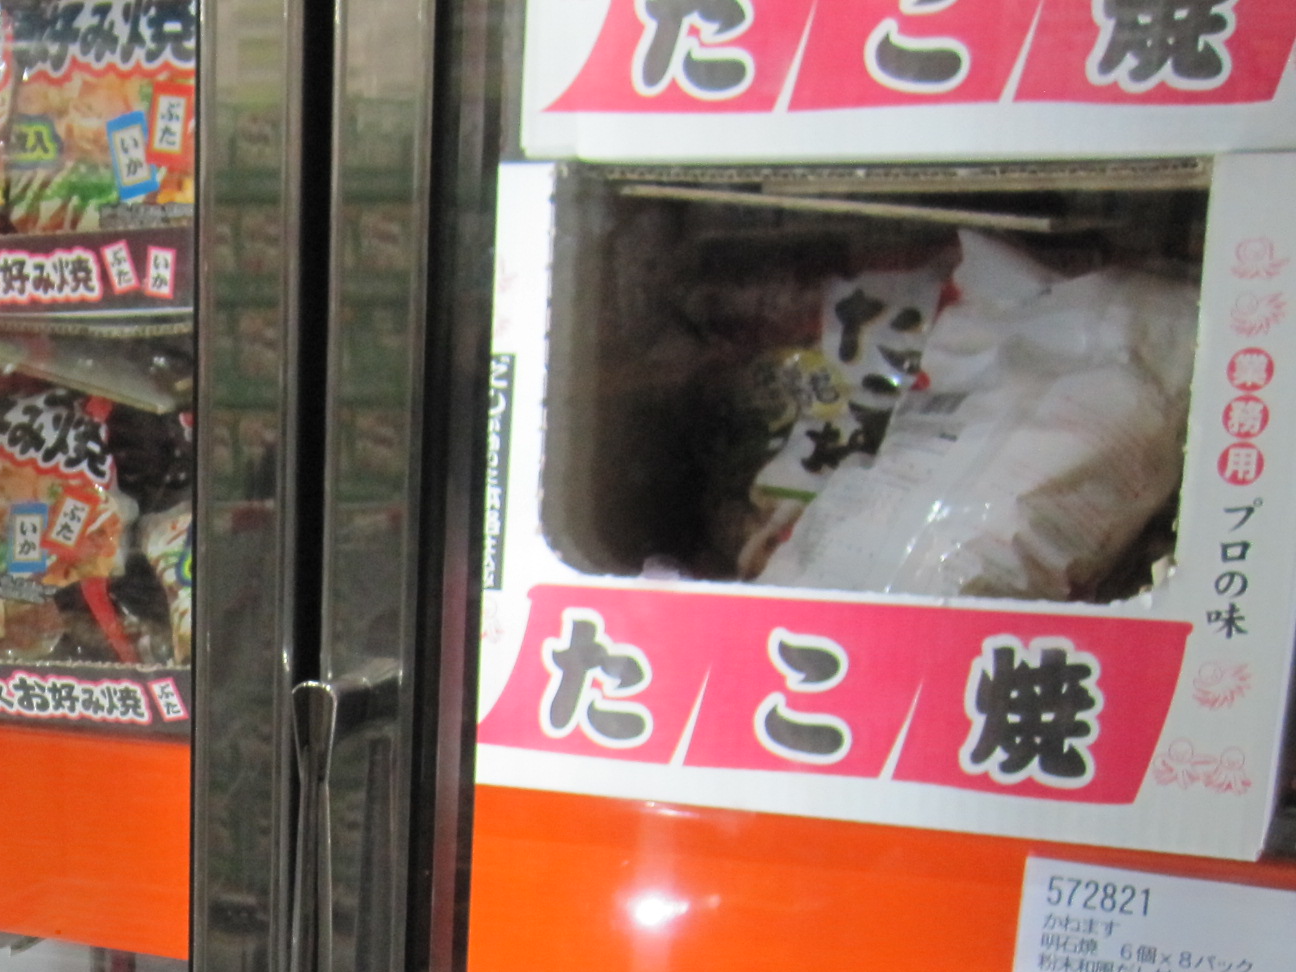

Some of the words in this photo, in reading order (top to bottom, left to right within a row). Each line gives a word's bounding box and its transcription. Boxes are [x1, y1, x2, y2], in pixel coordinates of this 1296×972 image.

[160, 101, 181, 147] ぶた
[120, 136, 144, 177] いか
[151, 255, 170, 293] いか
[1223, 350, 1270, 483] 業務用
[18, 519, 40, 555] いか
[54, 503, 87, 543] ぶた
[1206, 497, 1264, 639] プロの味
[158, 681, 183, 716] ぶた
[547, 617, 1096, 782] たこ焼
[1046, 874, 1152, 917] 572821
[1042, 912, 1121, 937] かねます
